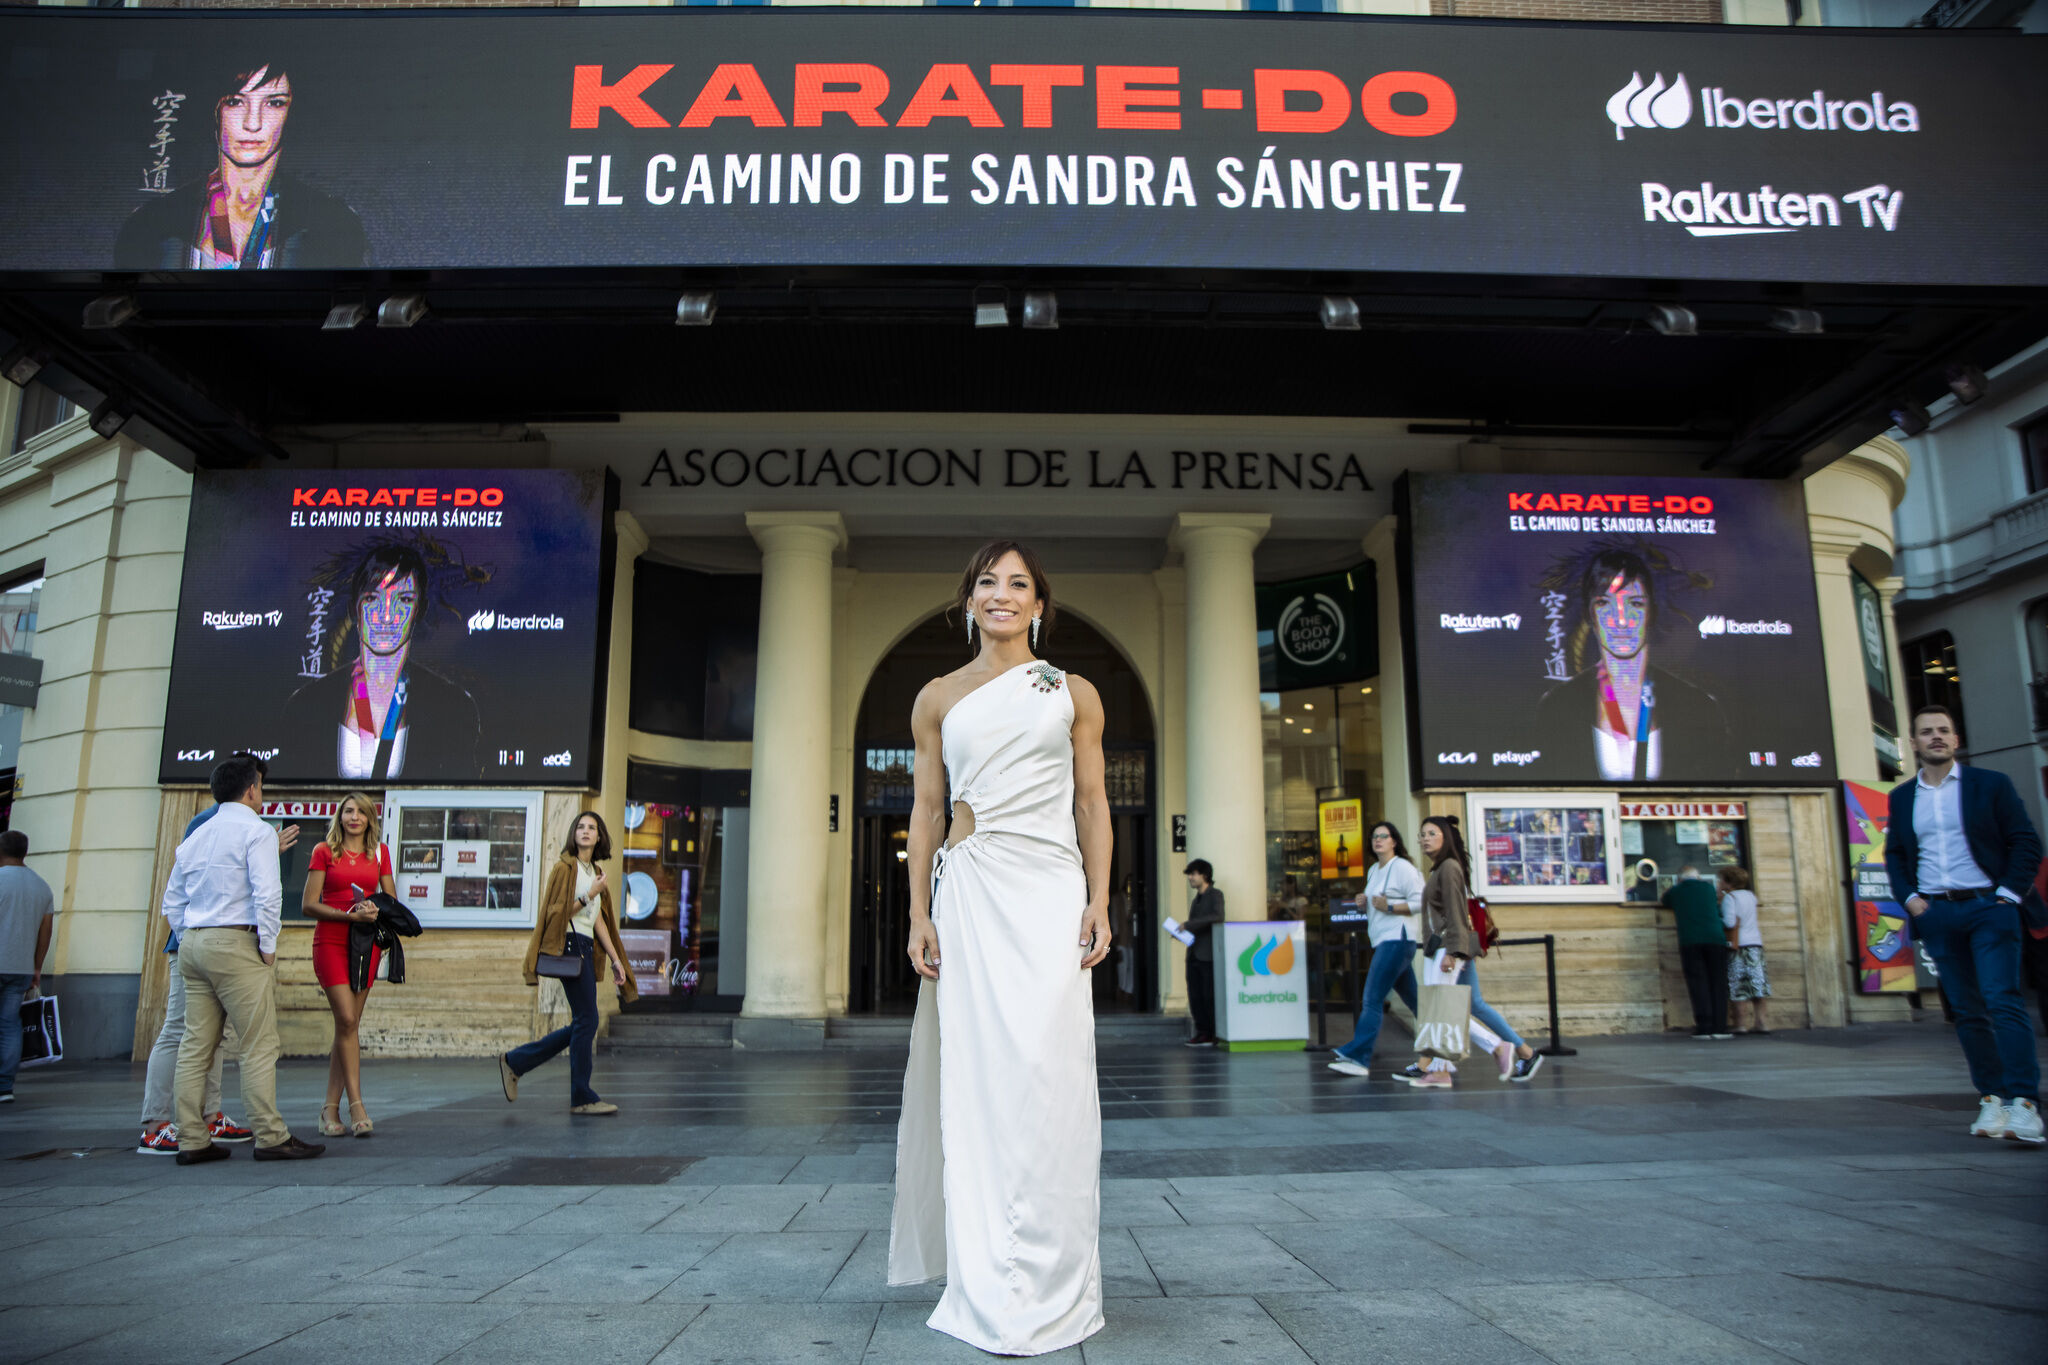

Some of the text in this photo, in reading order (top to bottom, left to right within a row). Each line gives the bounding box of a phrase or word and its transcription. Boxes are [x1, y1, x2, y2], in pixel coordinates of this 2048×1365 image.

[570, 64, 1457, 136] KARATE-DO
[1701, 87, 1920, 131] Iberdrola
[138, 89, 186, 193] 空手道
[564, 145, 1466, 213] EL CAMINO DE SANDRA SÁNCHEZ
[1641, 182, 1904, 231] Rakuten TV
[640, 448, 1374, 491] ASOCIACION DE LA PRENSA
[292, 488, 504, 507] KARATE-DO
[1508, 493, 1714, 514] KARATE-DO
[290, 508, 503, 528] EL CAMINO DE SANDRA SÁNCHEZ
[1510, 514, 1717, 534] EL CAMINO DE SANDRA SÁNCHEZ
[202, 609, 282, 627] Rakuten TV
[497, 613, 564, 630] Iberdrola
[1300, 614, 1321, 627] THE
[1440, 613, 1521, 631] Rakuten TV
[1726, 619, 1792, 635] Iberdrola
[298, 586, 335, 678] 空手道
[1291, 623, 1331, 641] BODY
[1540, 590, 1573, 681] 空手道
[1295, 638, 1331, 653] SHOP
[1493, 750, 1536, 767] pelayo
[1625, 803, 1740, 817] TAQUILLA
[1330, 914, 1368, 922] GENERA
[1238, 990, 1298, 1004] Iberdrola
